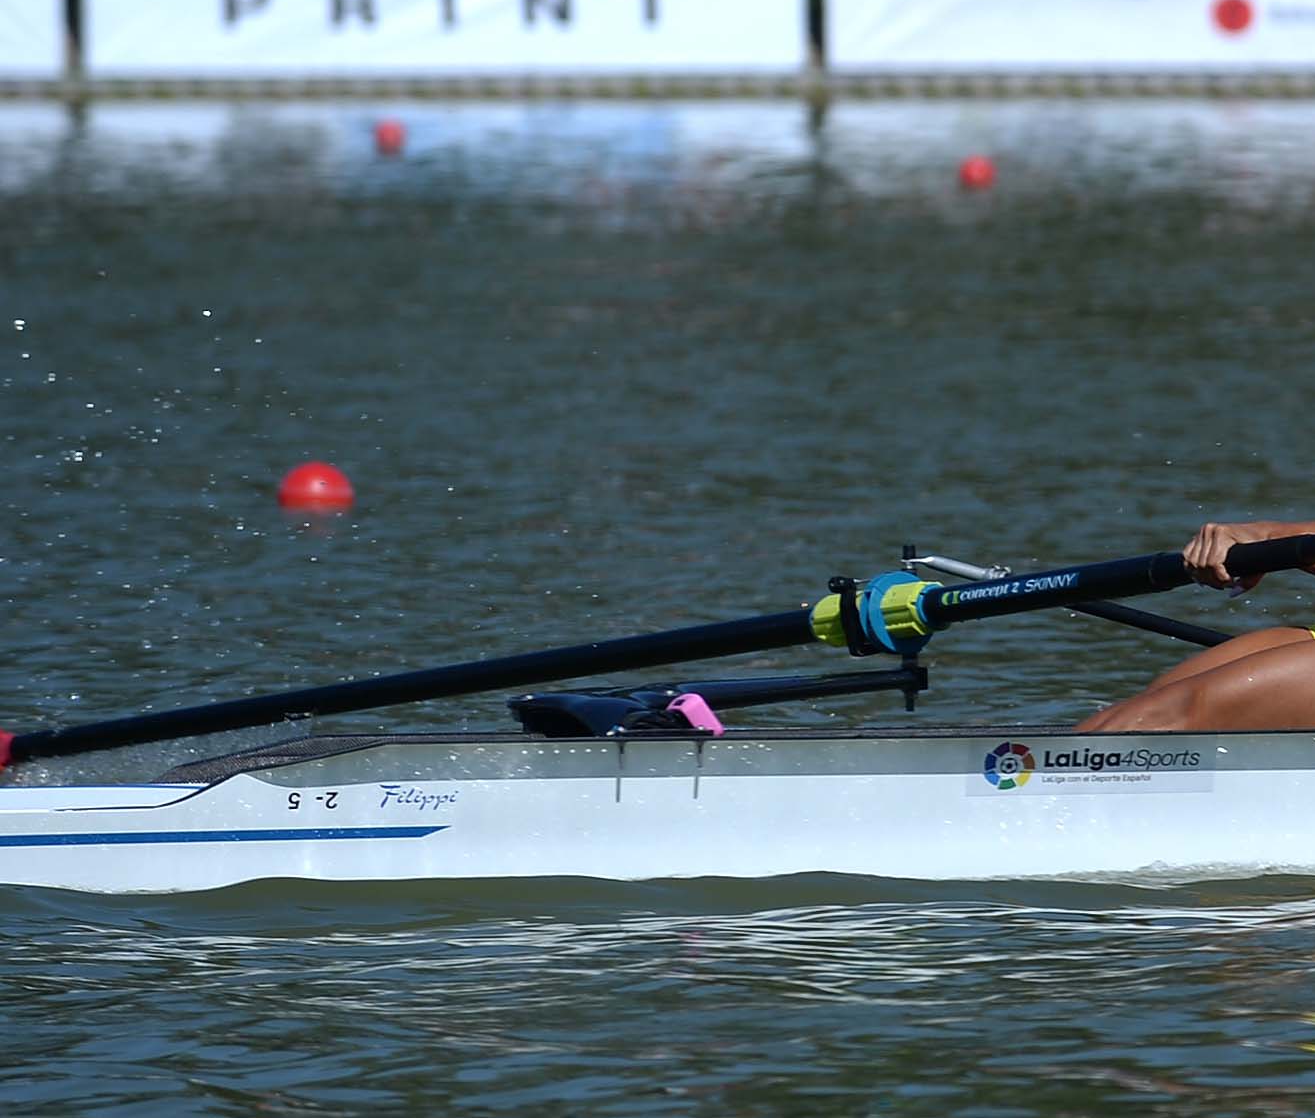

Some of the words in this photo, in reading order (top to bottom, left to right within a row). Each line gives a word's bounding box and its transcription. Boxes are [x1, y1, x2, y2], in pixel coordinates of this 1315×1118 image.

[960, 583, 1009, 601] concept
[1024, 572, 1078, 593] SKINNY
[1044, 748, 1200, 771] LaLiga4Sports
[379, 784, 459, 811] Filippi
